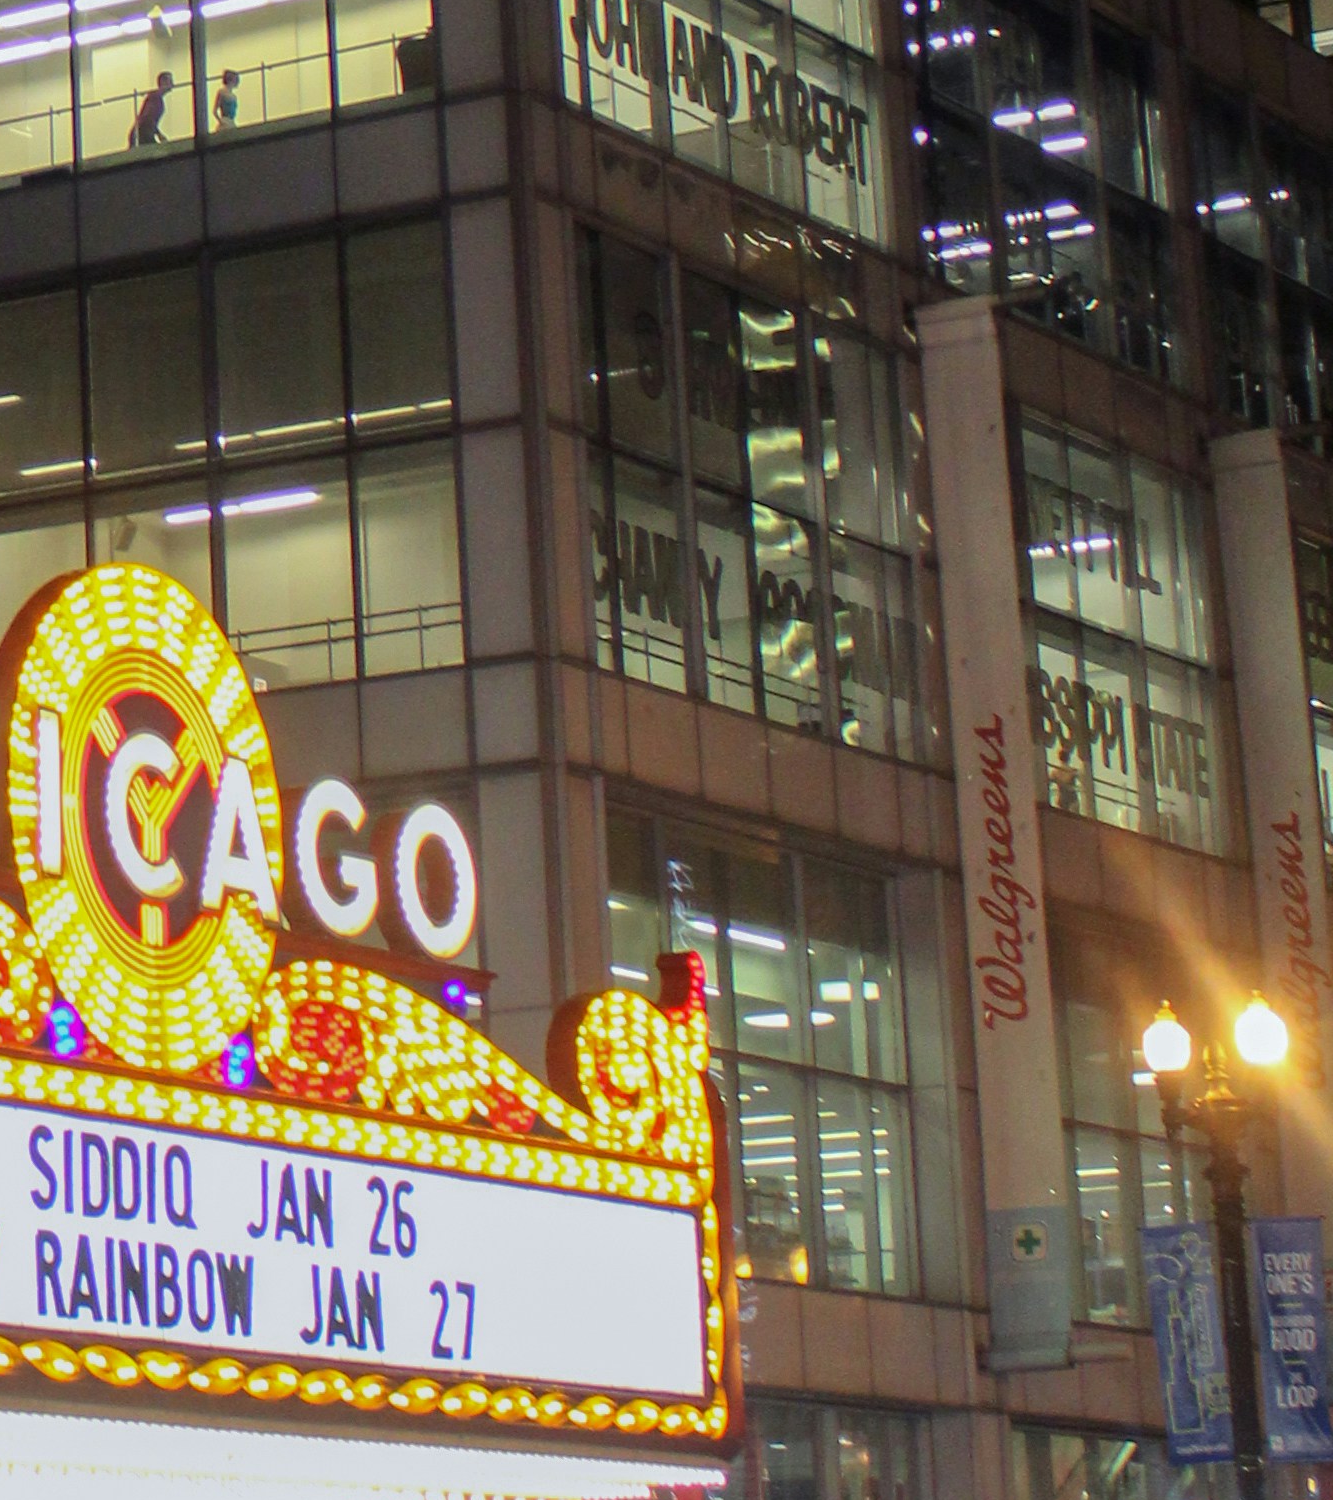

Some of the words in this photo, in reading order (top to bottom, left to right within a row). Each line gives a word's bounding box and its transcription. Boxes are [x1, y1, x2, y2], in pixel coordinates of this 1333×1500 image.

[672, 12, 738, 120] AND
[745, 50, 869, 187] ROBERT
[973, 713, 1036, 1031] Walgreens
[28, 1124, 198, 1230] SIDDIQ
[247, 1158, 336, 1251] JAN
[366, 1175, 418, 1259] 26
[34, 1229, 254, 1338] RAINBOW
[298, 1264, 385, 1353] JAN
[429, 1280, 476, 1362] 27
[1262, 1251, 1313, 1273] EVERY
[1276, 1384, 1318, 1408] LOOP
